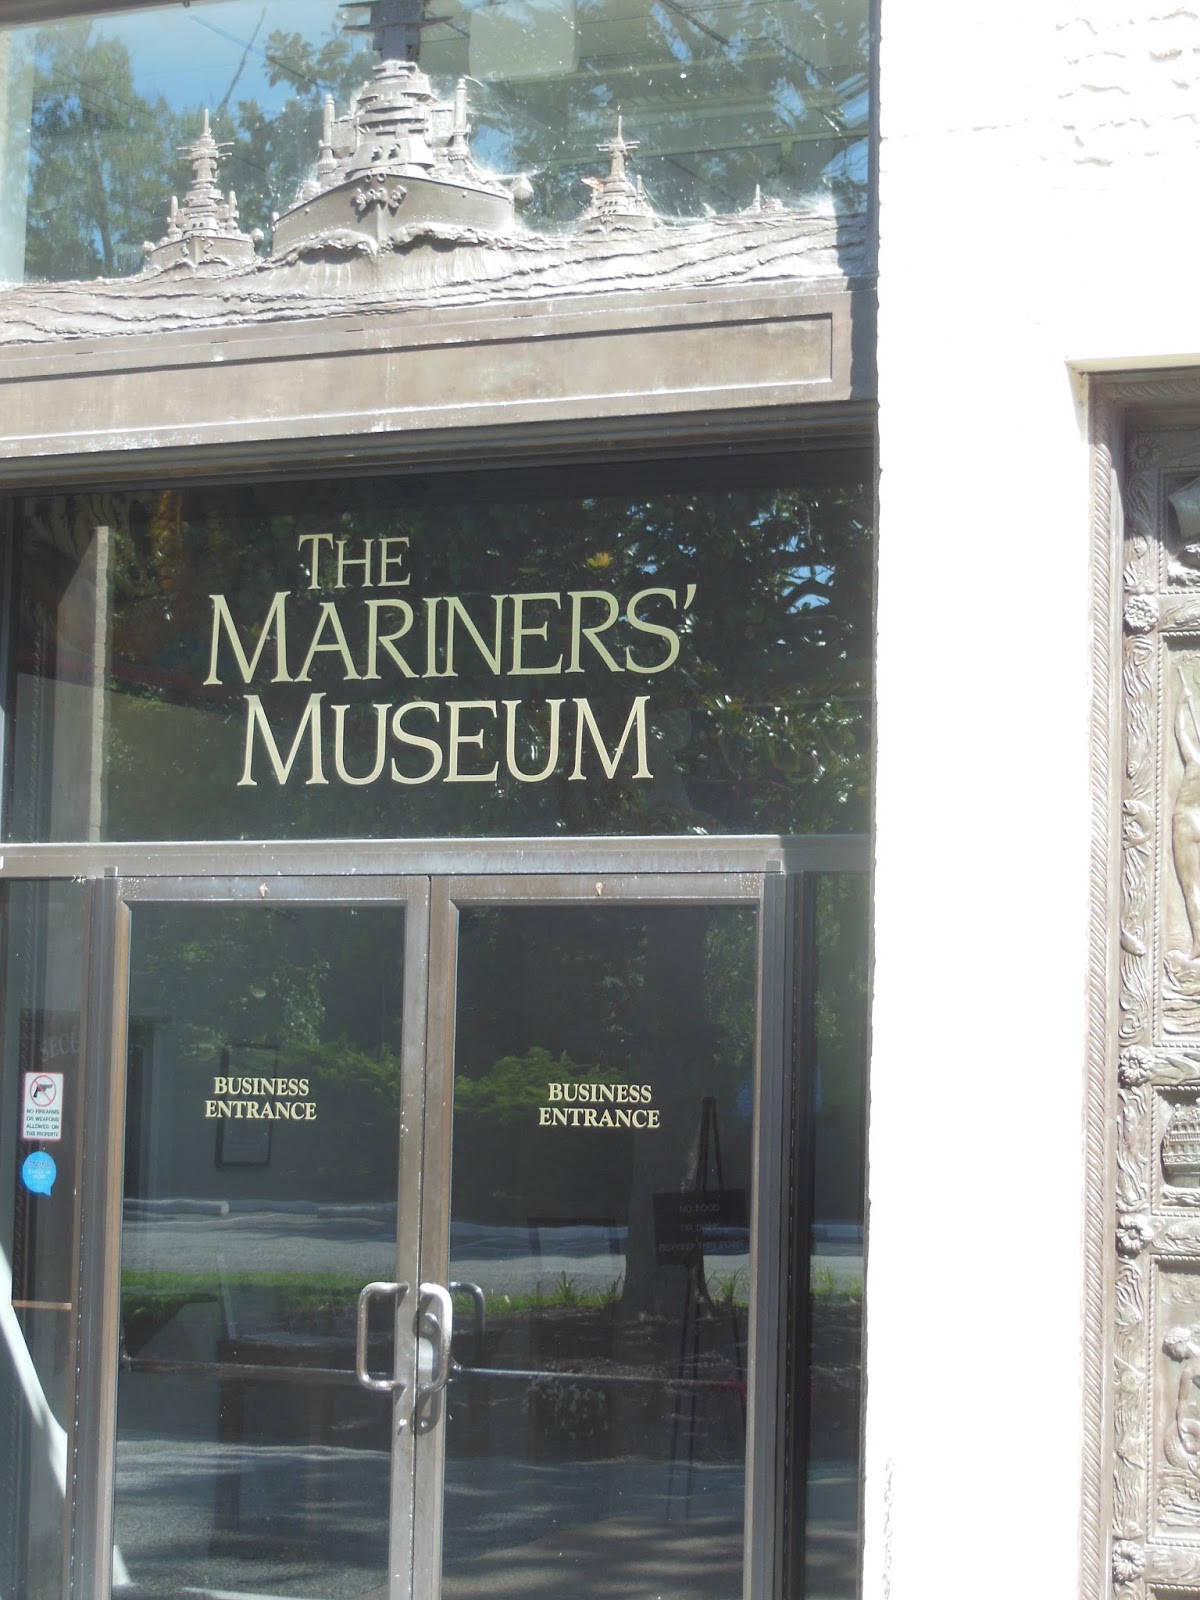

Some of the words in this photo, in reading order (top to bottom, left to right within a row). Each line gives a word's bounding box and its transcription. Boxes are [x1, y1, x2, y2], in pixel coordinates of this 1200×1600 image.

[298, 532, 411, 590] THE
[203, 584, 697, 686] MARINERS'
[237, 692, 653, 786] MUSEUM
[214, 1076, 309, 1096] BUSINESS
[548, 1083, 652, 1103] BUSINESS
[205, 1100, 317, 1120] ENTRANCE
[539, 1107, 660, 1128] ENTRANCE
